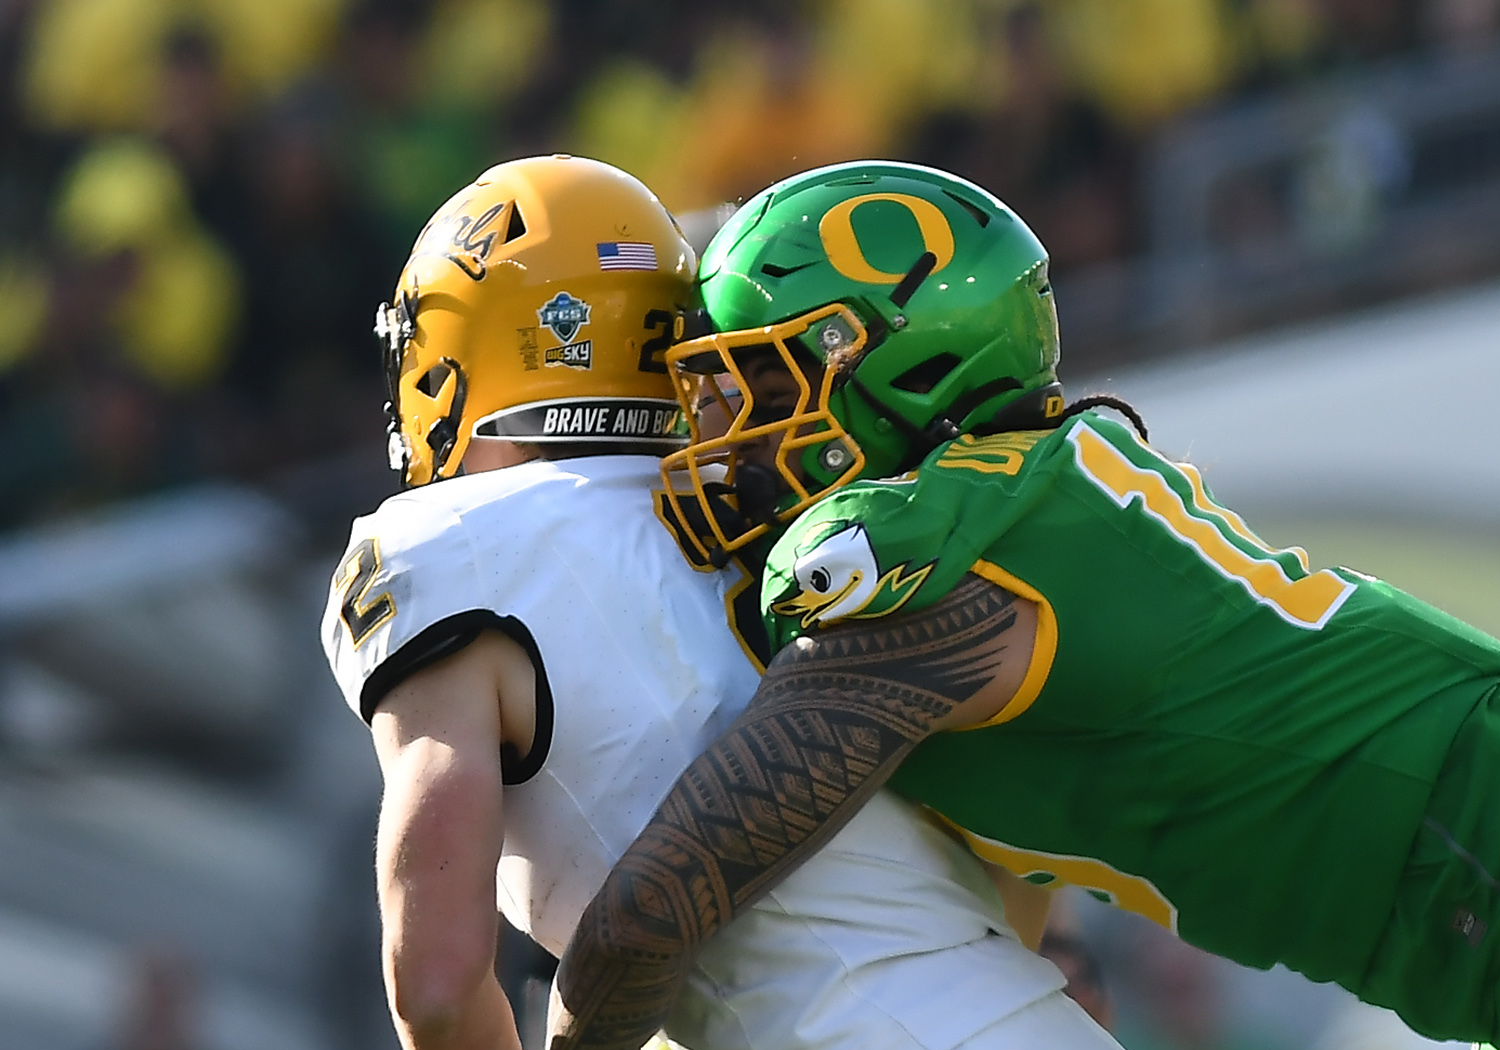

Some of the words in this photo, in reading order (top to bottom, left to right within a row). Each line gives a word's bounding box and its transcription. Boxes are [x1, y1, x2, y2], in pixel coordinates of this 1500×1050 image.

[818, 192, 956, 285] O
[546, 309, 582, 321] FCS
[543, 407, 609, 434] BRAVE
[612, 408, 649, 434] AND
[335, 537, 397, 652] 2
